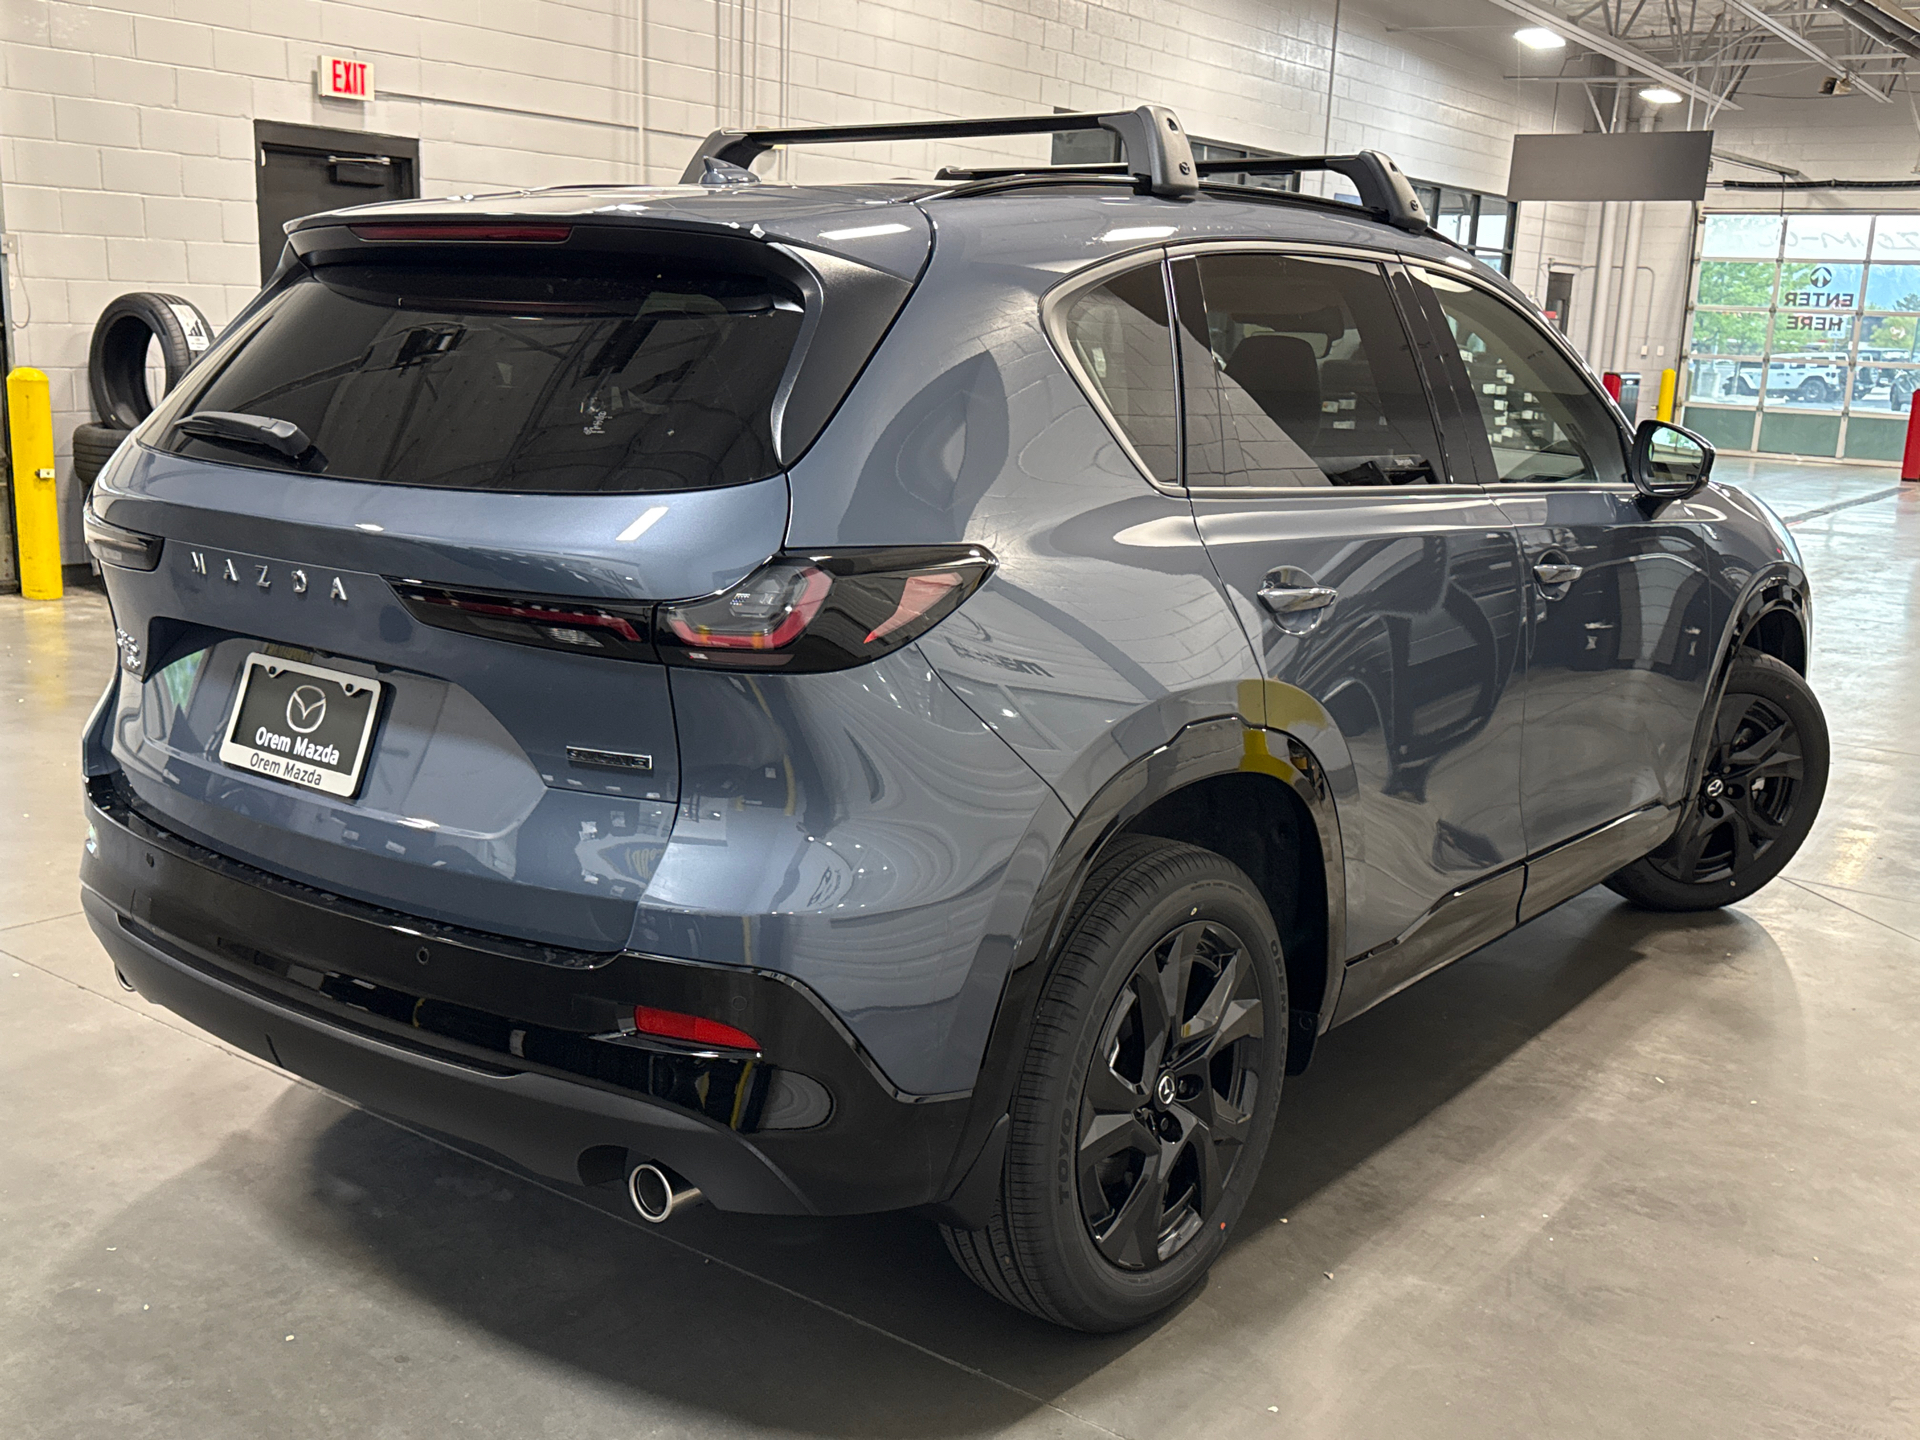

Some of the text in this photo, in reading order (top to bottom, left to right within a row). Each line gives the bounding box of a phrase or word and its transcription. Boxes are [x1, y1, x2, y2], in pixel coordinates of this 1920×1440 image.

[332, 59, 367, 96] EXIT
[190, 551, 348, 601] MAZDA
[255, 726, 340, 766] Orem Mazda
[250, 752, 322, 786] Orem Mazda
[1270, 939, 1287, 1014] OPEN
[1057, 1108, 1073, 1206] TOYO
